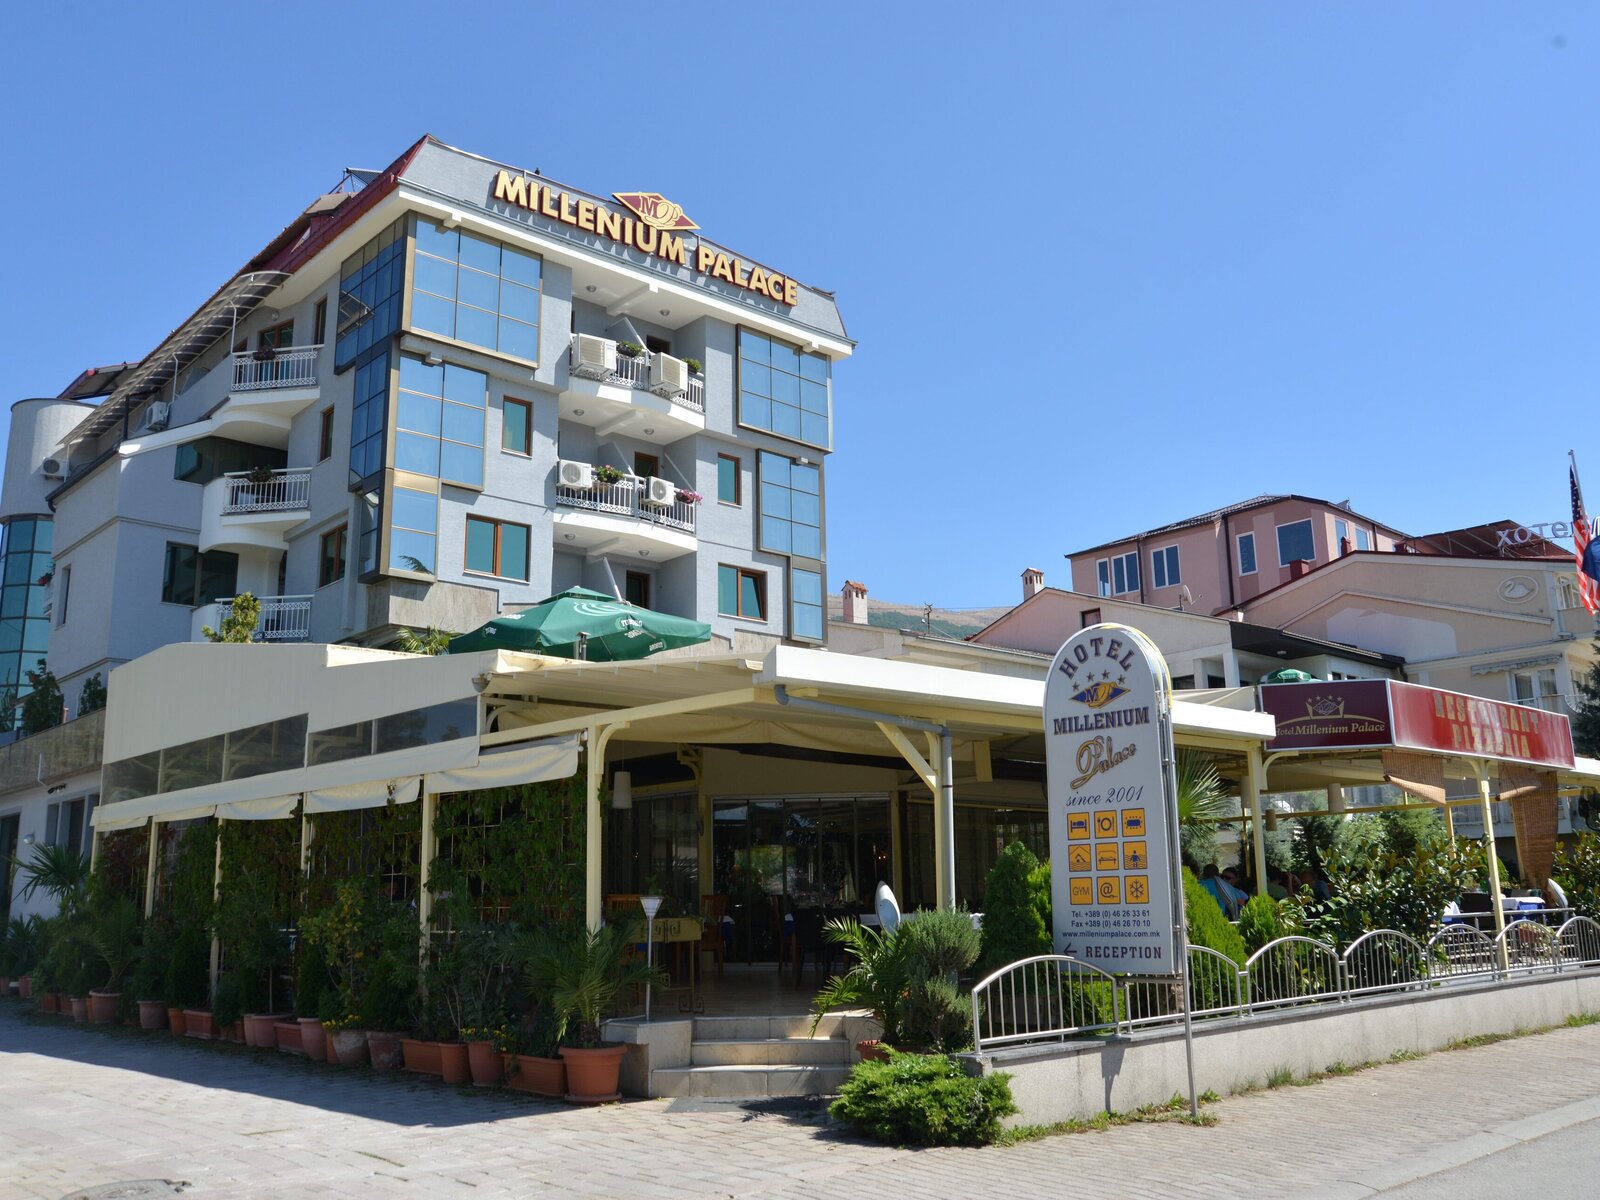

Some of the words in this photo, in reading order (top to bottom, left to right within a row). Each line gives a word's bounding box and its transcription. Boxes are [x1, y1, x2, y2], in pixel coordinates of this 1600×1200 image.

[494, 169, 686, 265] MILLENIUM
[697, 245, 798, 307] PALACE
[1059, 636, 1135, 680] HOTEL
[1053, 706, 1150, 736] MILLENIUM
[1433, 691, 1539, 735] RESTAURANT
[1295, 724, 1348, 736] Millenium
[1351, 722, 1385, 733] Palace
[1452, 723, 1531, 758] PIZZERIA
[1070, 735, 1138, 789] Palace
[1066, 791, 1101, 807] since
[1105, 785, 1144, 804] 2001
[1072, 885, 1090, 897] GYM
[1071, 920, 1083, 928] Fax
[1112, 910, 1120, 918] 46
[1062, 930, 1161, 939] www.milleniumpalace.com.mk
[1085, 946, 1162, 959] RECEPTION
